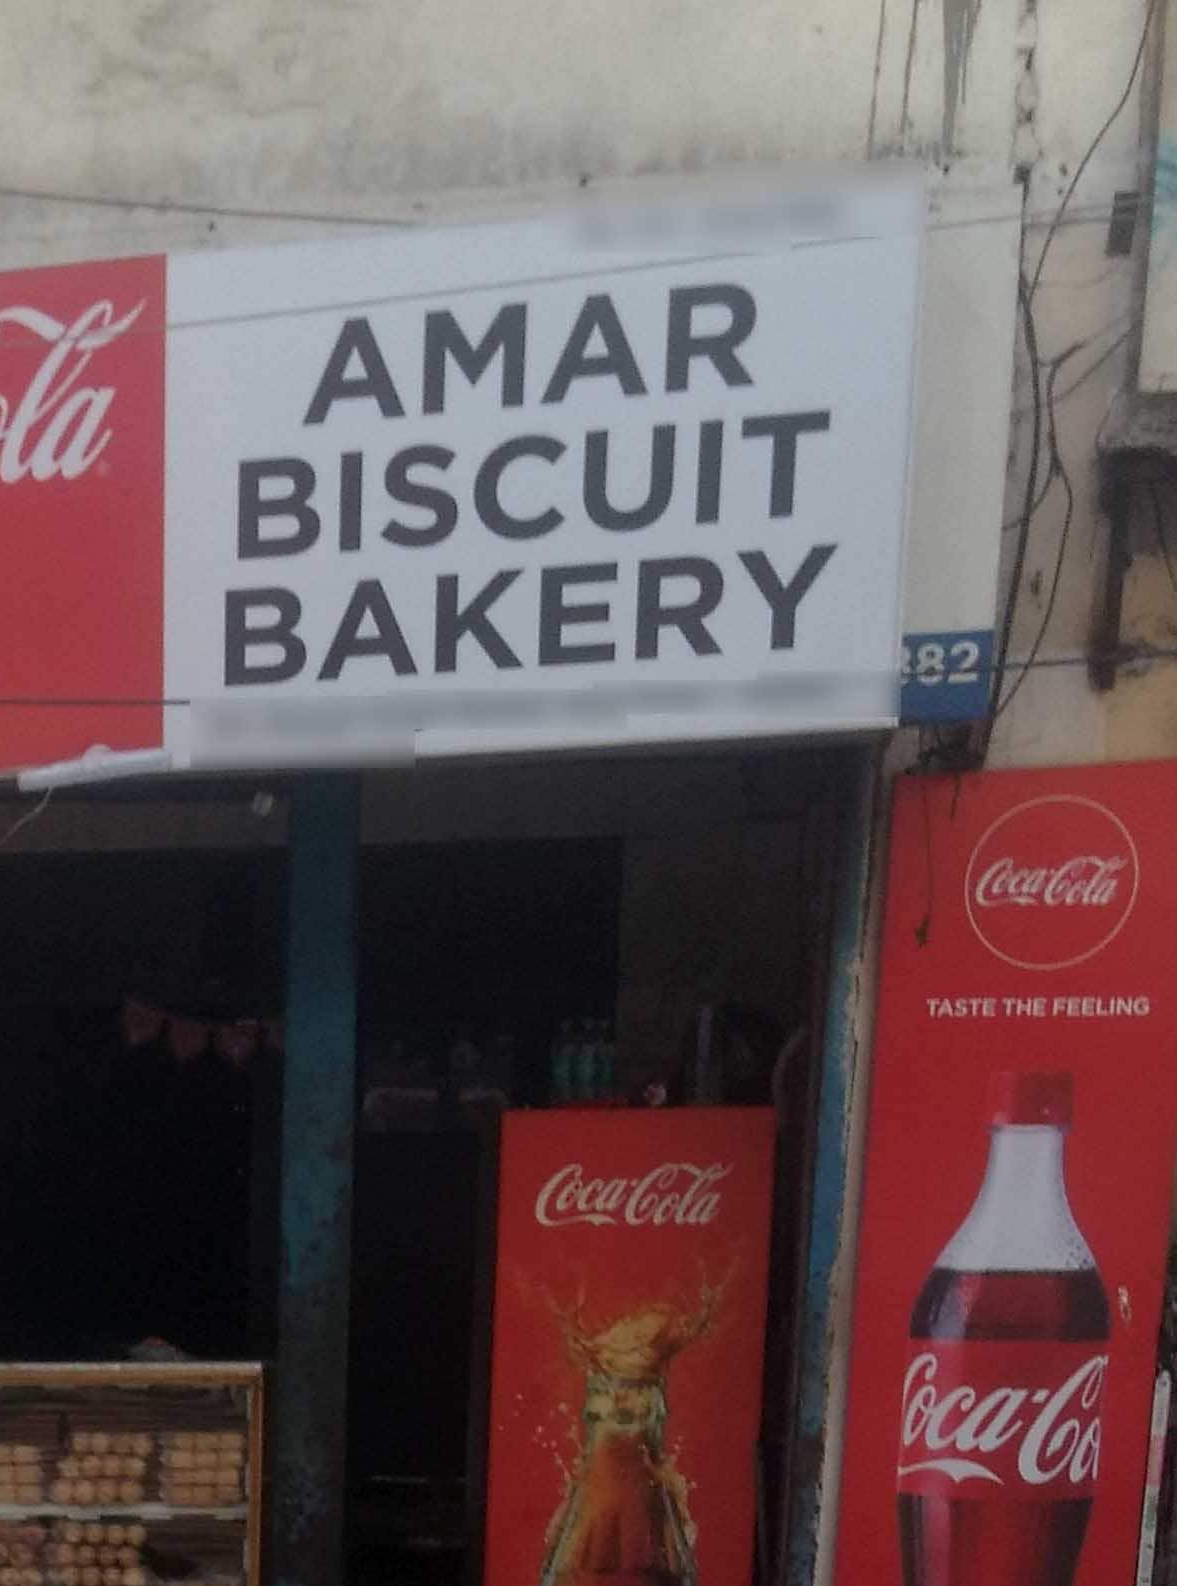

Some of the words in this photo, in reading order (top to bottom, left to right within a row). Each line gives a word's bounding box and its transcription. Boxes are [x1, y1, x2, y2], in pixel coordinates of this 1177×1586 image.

[302, 282, 758, 426] AMAR
[236, 408, 832, 562] BISCUIT
[223, 543, 839, 688] BAKERY
[975, 855, 1127, 907] Coca-Cola
[926, 996, 997, 1019] TASTE
[1002, 996, 1048, 1019] THE
[1052, 994, 1151, 1018] FEELING
[534, 1161, 734, 1227] Coca-Cola
